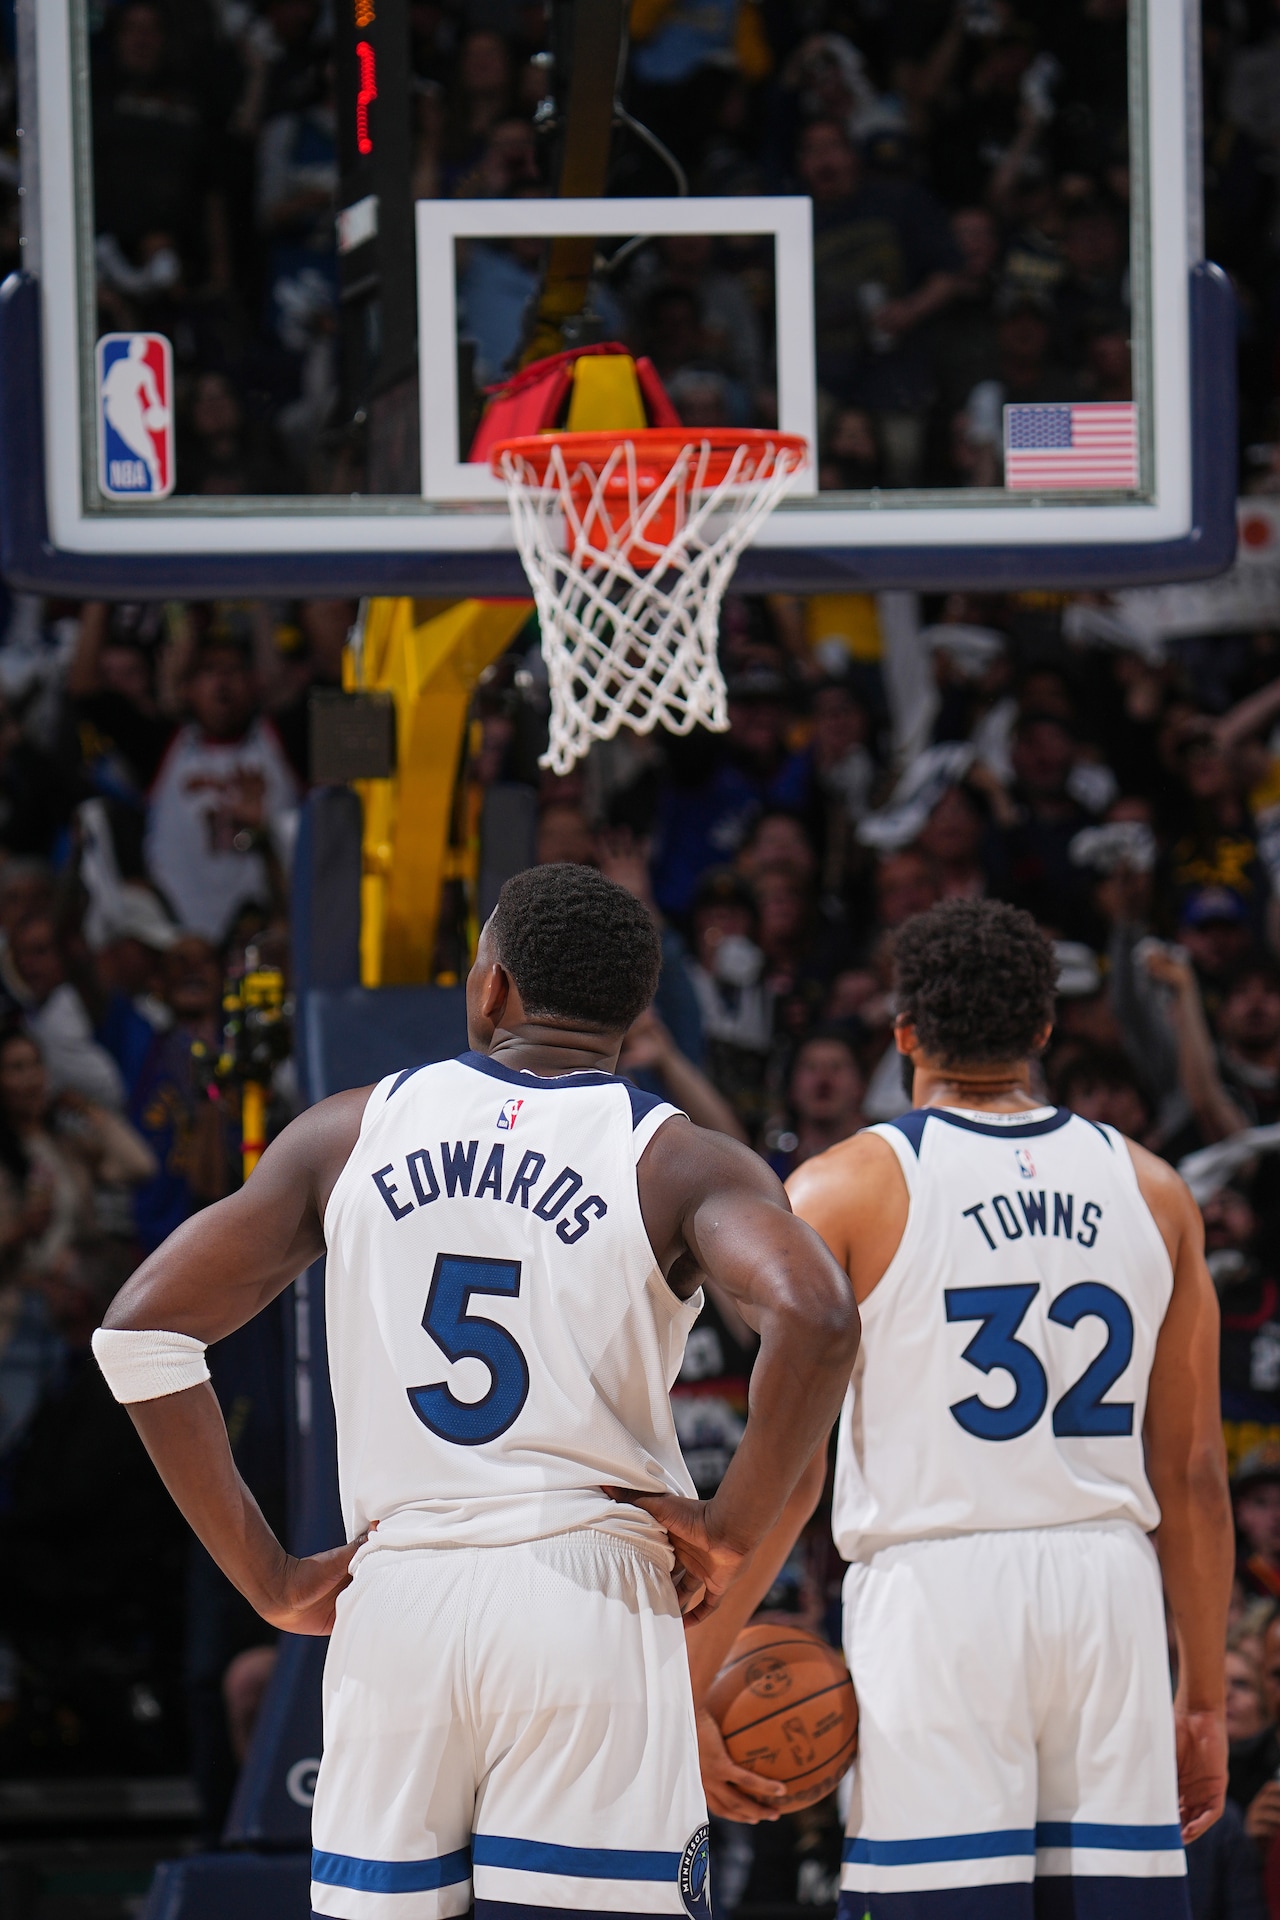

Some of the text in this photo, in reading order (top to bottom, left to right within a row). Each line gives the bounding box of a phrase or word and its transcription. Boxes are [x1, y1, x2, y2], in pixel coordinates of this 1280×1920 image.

[110, 459, 147, 489] NBA
[371, 1140, 608, 1245] EDWARDS
[962, 1190, 1103, 1251] TOWNS
[406, 1253, 530, 1447] 5
[944, 1281, 1134, 1441] 32
